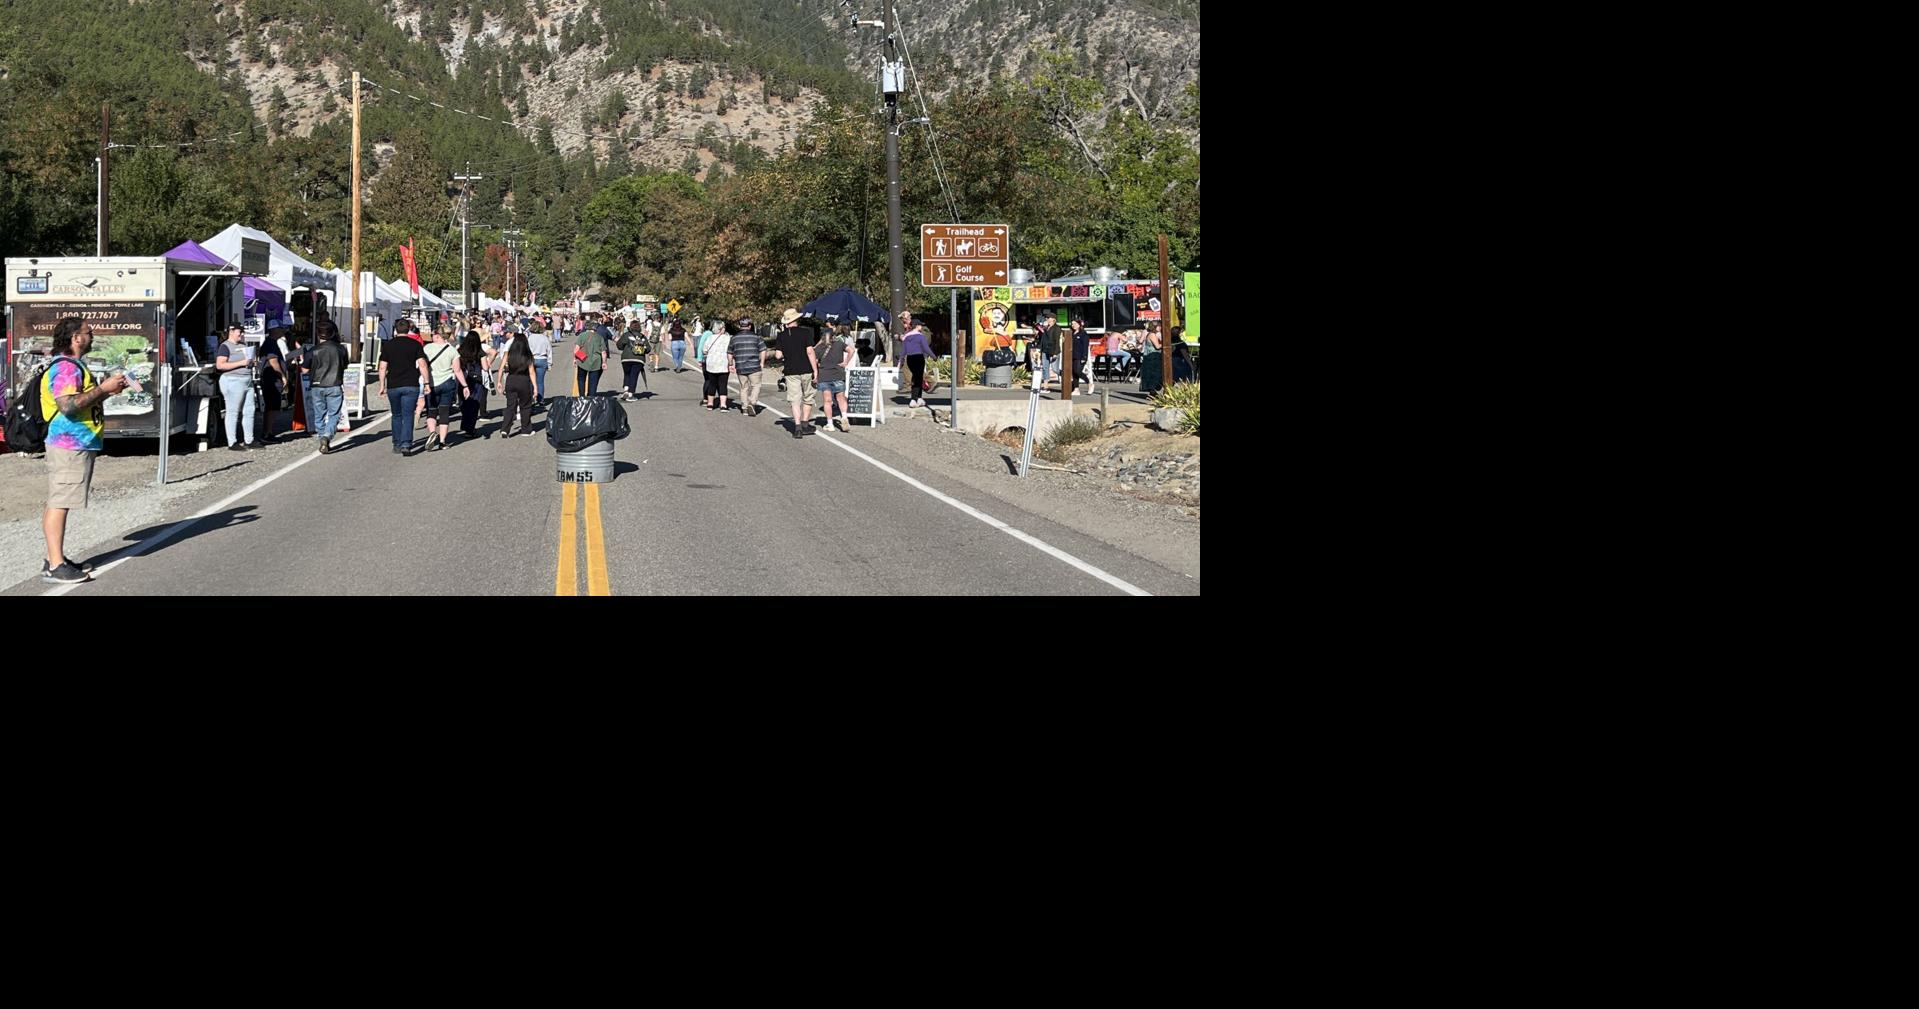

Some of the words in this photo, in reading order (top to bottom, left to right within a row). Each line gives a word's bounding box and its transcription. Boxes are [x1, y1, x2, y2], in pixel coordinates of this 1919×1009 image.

[946, 227, 985, 236] Trailhead
[955, 265, 973, 273] Golf
[955, 273, 985, 282] Course
[52, 285, 87, 293] CARSON
[91, 285, 126, 293] VALLEY
[56, 311, 119, 319] 1.800727.7677
[557, 470, 575, 482] TBM
